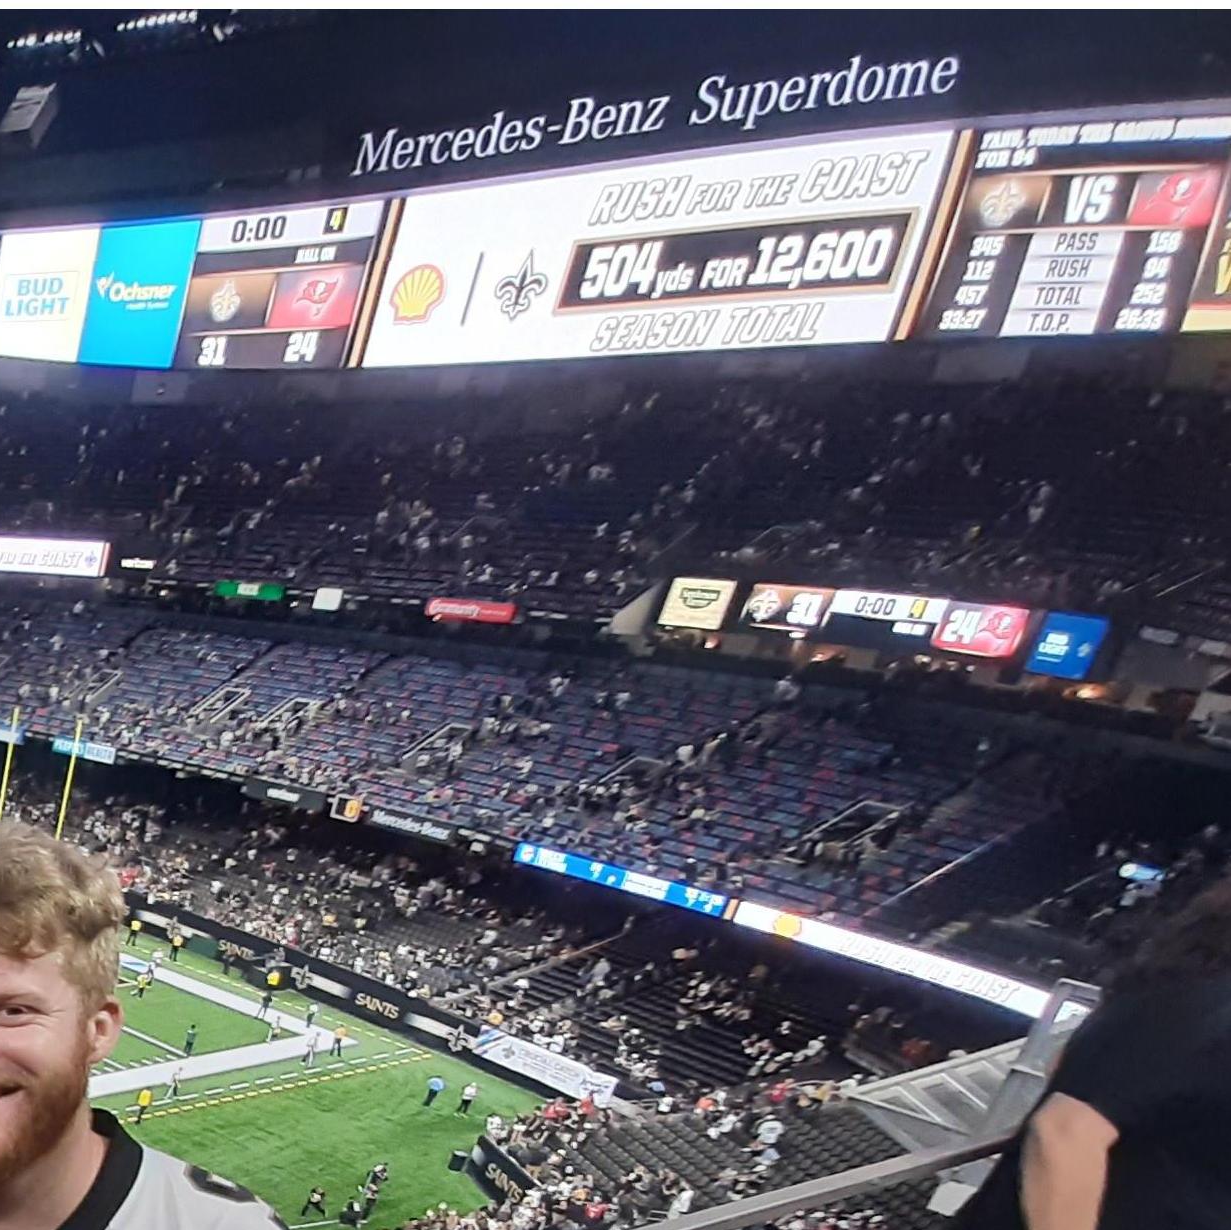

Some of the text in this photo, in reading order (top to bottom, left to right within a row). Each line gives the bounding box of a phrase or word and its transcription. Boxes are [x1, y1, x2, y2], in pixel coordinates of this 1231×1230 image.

[349, 55, 961, 177] Mercedes-Benz Superdome
[587, 150, 931, 226] RUSH FOR THE COAST
[1063, 176, 1118, 223] VS
[231, 215, 287, 243] 0:00
[1054, 232, 1099, 251] PASS
[699, 258, 747, 291] FOR
[746, 229, 895, 291] 12,600
[1045, 259, 1092, 278] RUSH
[16, 277, 64, 297] BUD
[109, 281, 178, 303] Ochsner
[1032, 286, 1081, 305] TOTAL
[4, 297, 69, 316] LIGHT
[588, 303, 825, 353] SEASON TOTAL
[1028, 313, 1070, 332] T.O.P.
[198, 332, 319, 365] 31 24
[855, 596, 897, 616] 0:00
[942, 609, 983, 644] 24
[354, 993, 399, 1019] SAINTS
[485, 1163, 523, 1204] SAINTS
